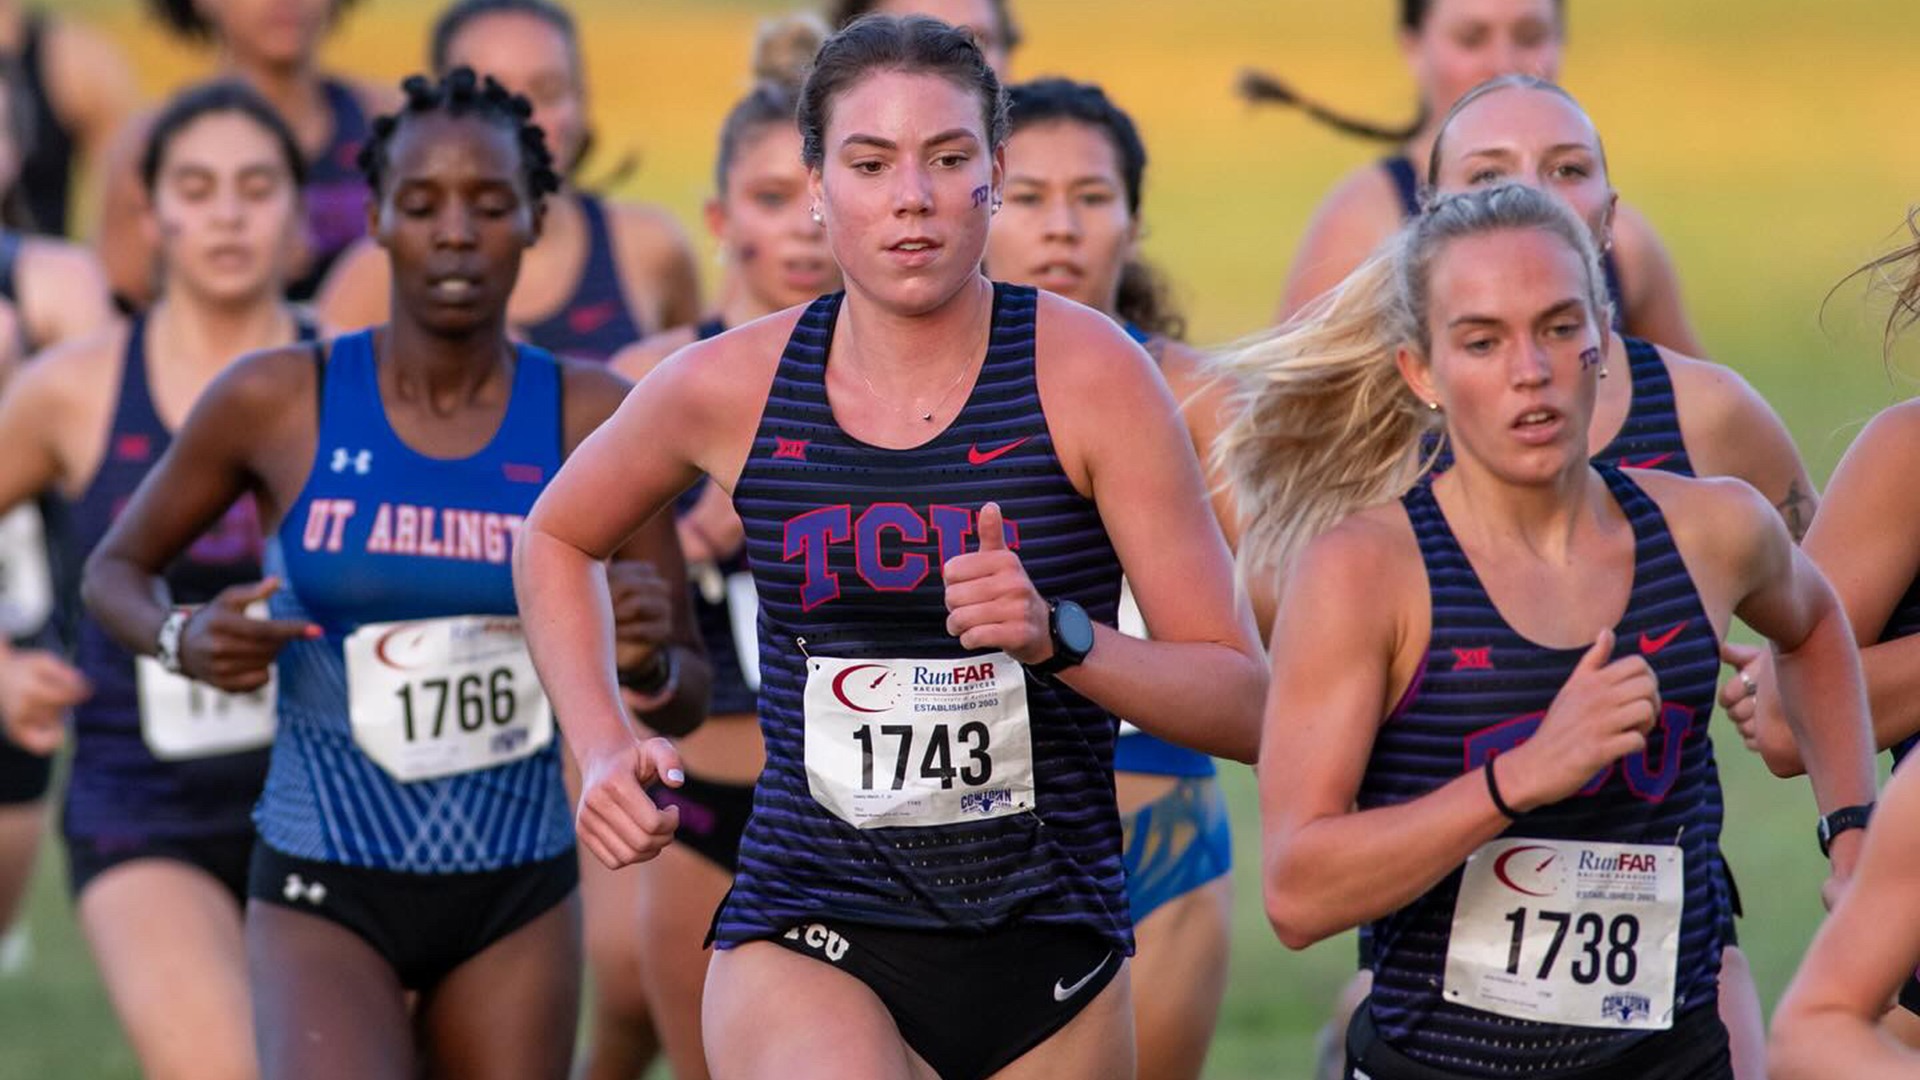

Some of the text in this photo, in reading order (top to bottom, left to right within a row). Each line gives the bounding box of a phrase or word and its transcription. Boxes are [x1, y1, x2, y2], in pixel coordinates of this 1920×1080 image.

[302, 499, 355, 552] UT
[395, 666, 516, 742] 1766
[913, 662, 995, 685] RunFAR
[914, 698, 999, 712] ESTABLISHED 2003
[853, 721, 993, 791] 1743
[1505, 907, 1640, 986] 1738
